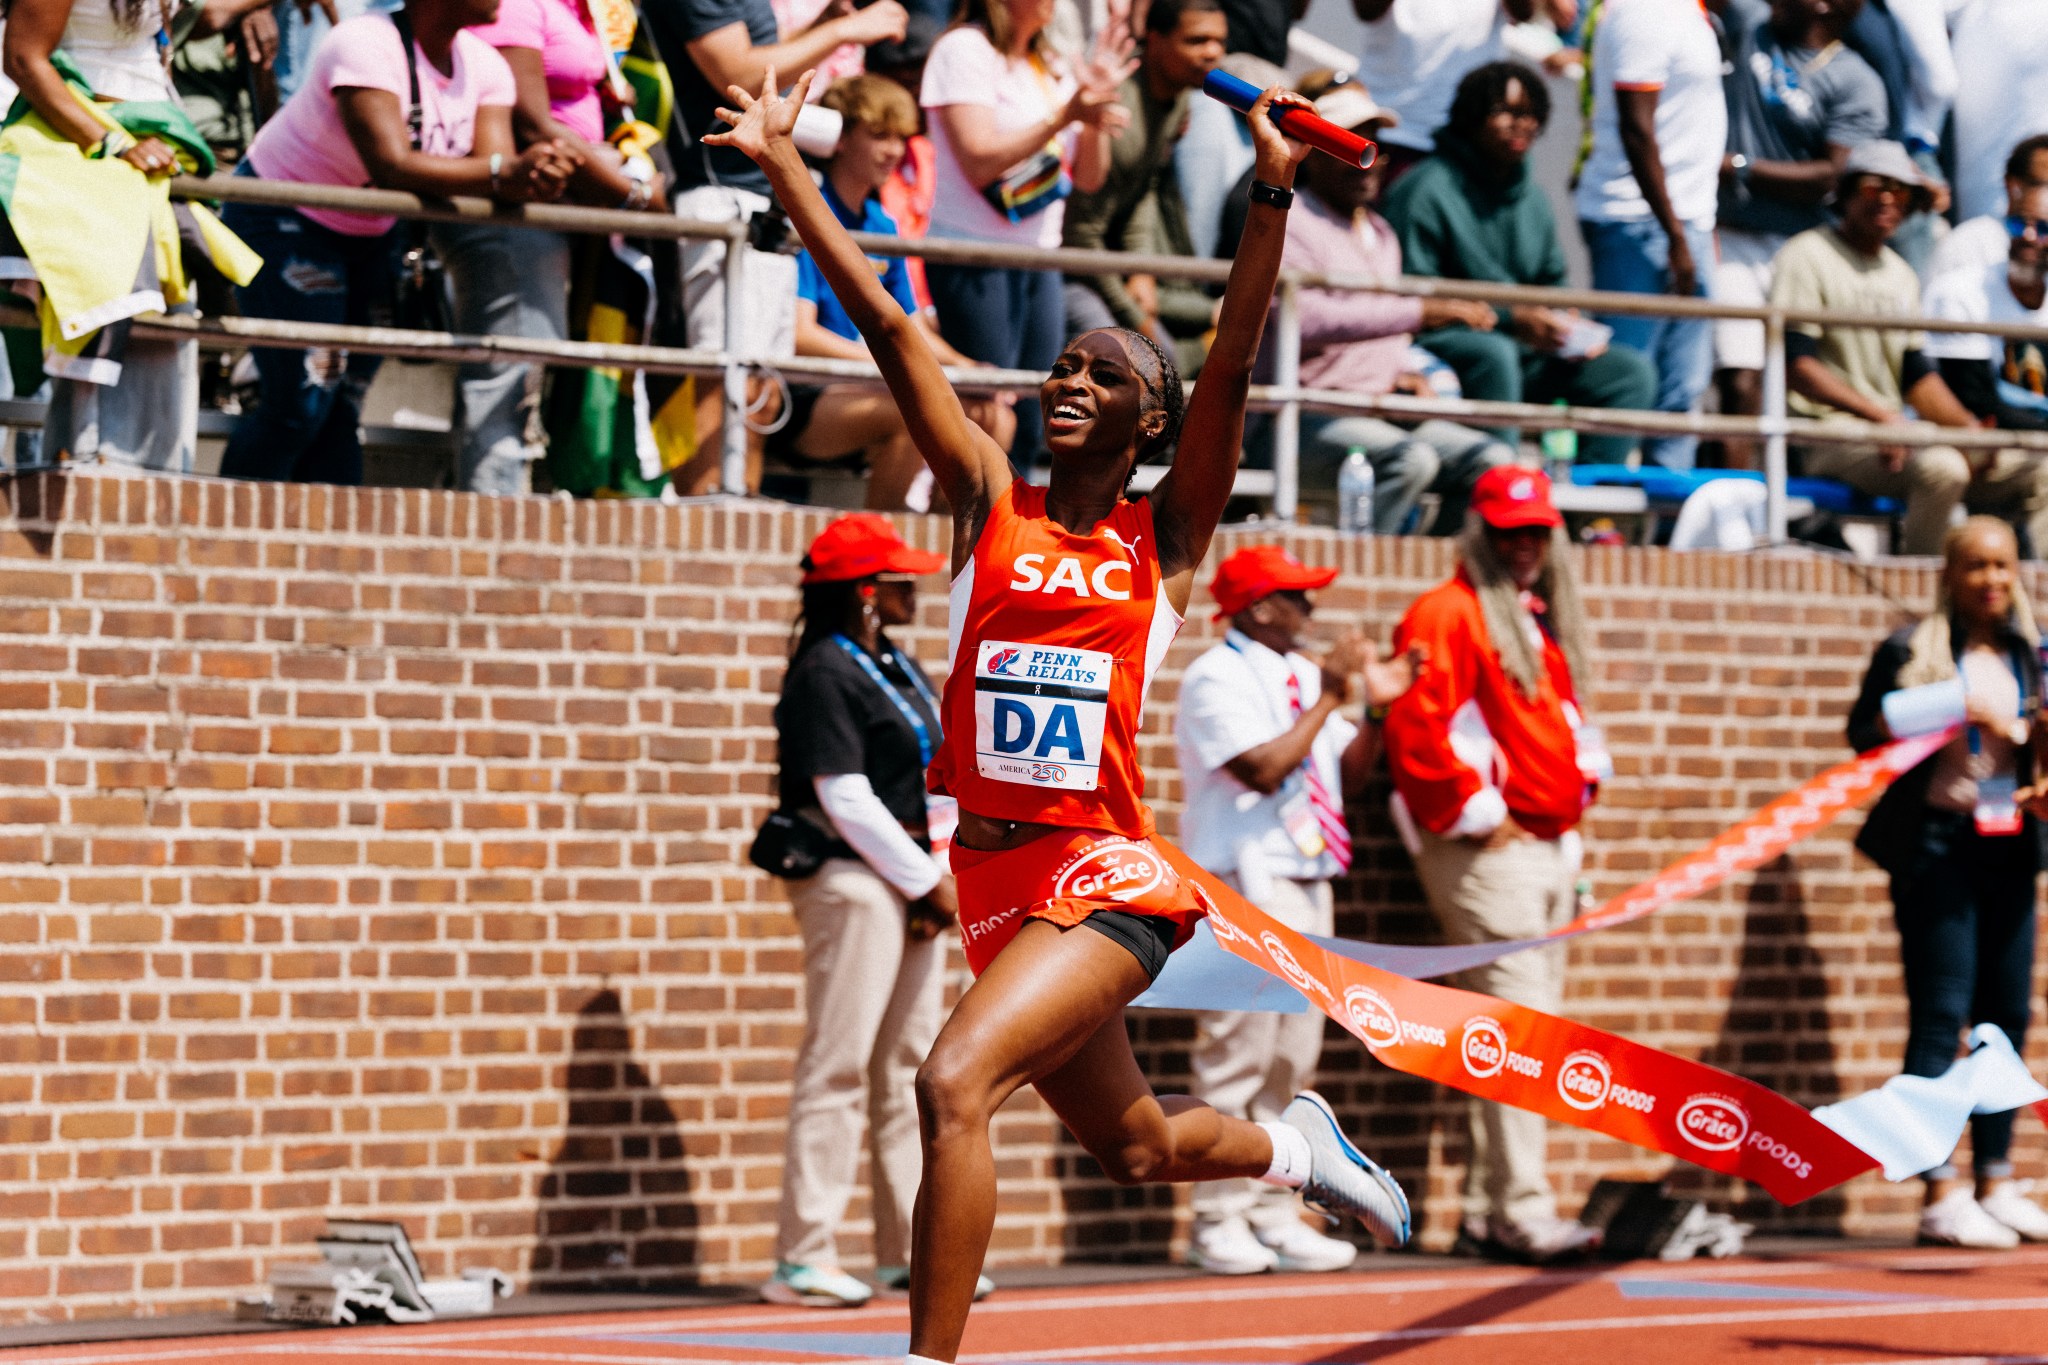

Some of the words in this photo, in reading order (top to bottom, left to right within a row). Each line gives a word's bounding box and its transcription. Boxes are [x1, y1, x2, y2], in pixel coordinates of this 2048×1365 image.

[1010, 553, 1131, 601] SAC
[1025, 664, 1097, 684] RELAYS
[1030, 650, 1083, 668] PENN
[993, 697, 1086, 762] DA
[997, 764, 1031, 775] AMERICA
[1032, 763, 1067, 783] 250
[1051, 844, 1092, 882] QUALITY
[1094, 836, 1128, 848] SINCE
[1071, 861, 1152, 897] Grace
[1352, 1004, 1394, 1034] Grace
[1401, 1020, 1447, 1047] FOODS
[1468, 1036, 1499, 1065] Grace
[1506, 1051, 1543, 1078] FOODS
[1565, 1068, 1602, 1097] Grace
[1609, 1083, 1656, 1113] FOODS
[1686, 1108, 1738, 1140] Grace
[1747, 1130, 1813, 1179] FOODS
